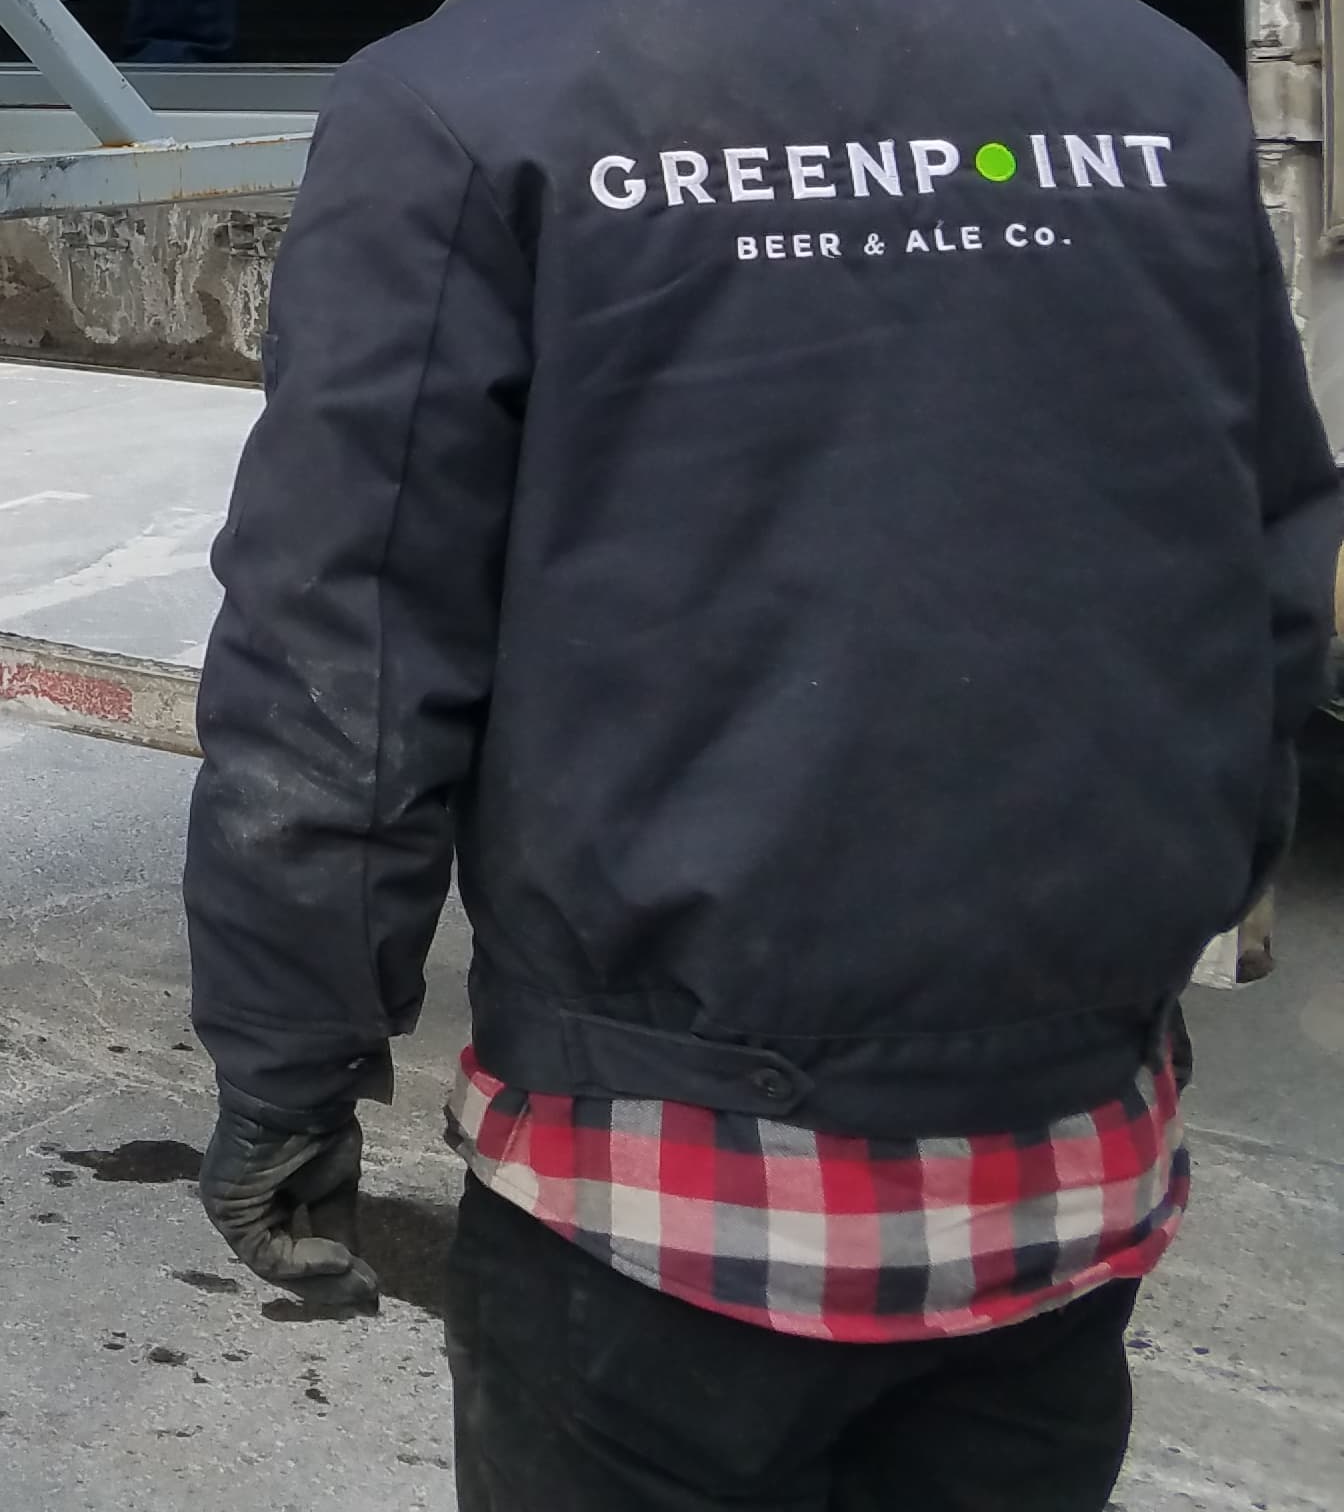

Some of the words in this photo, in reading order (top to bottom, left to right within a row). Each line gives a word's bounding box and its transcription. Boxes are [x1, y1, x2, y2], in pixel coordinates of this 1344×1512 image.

[736, 232, 844, 261] BEER
[863, 232, 887, 257] &
[905, 224, 984, 254] ALE
